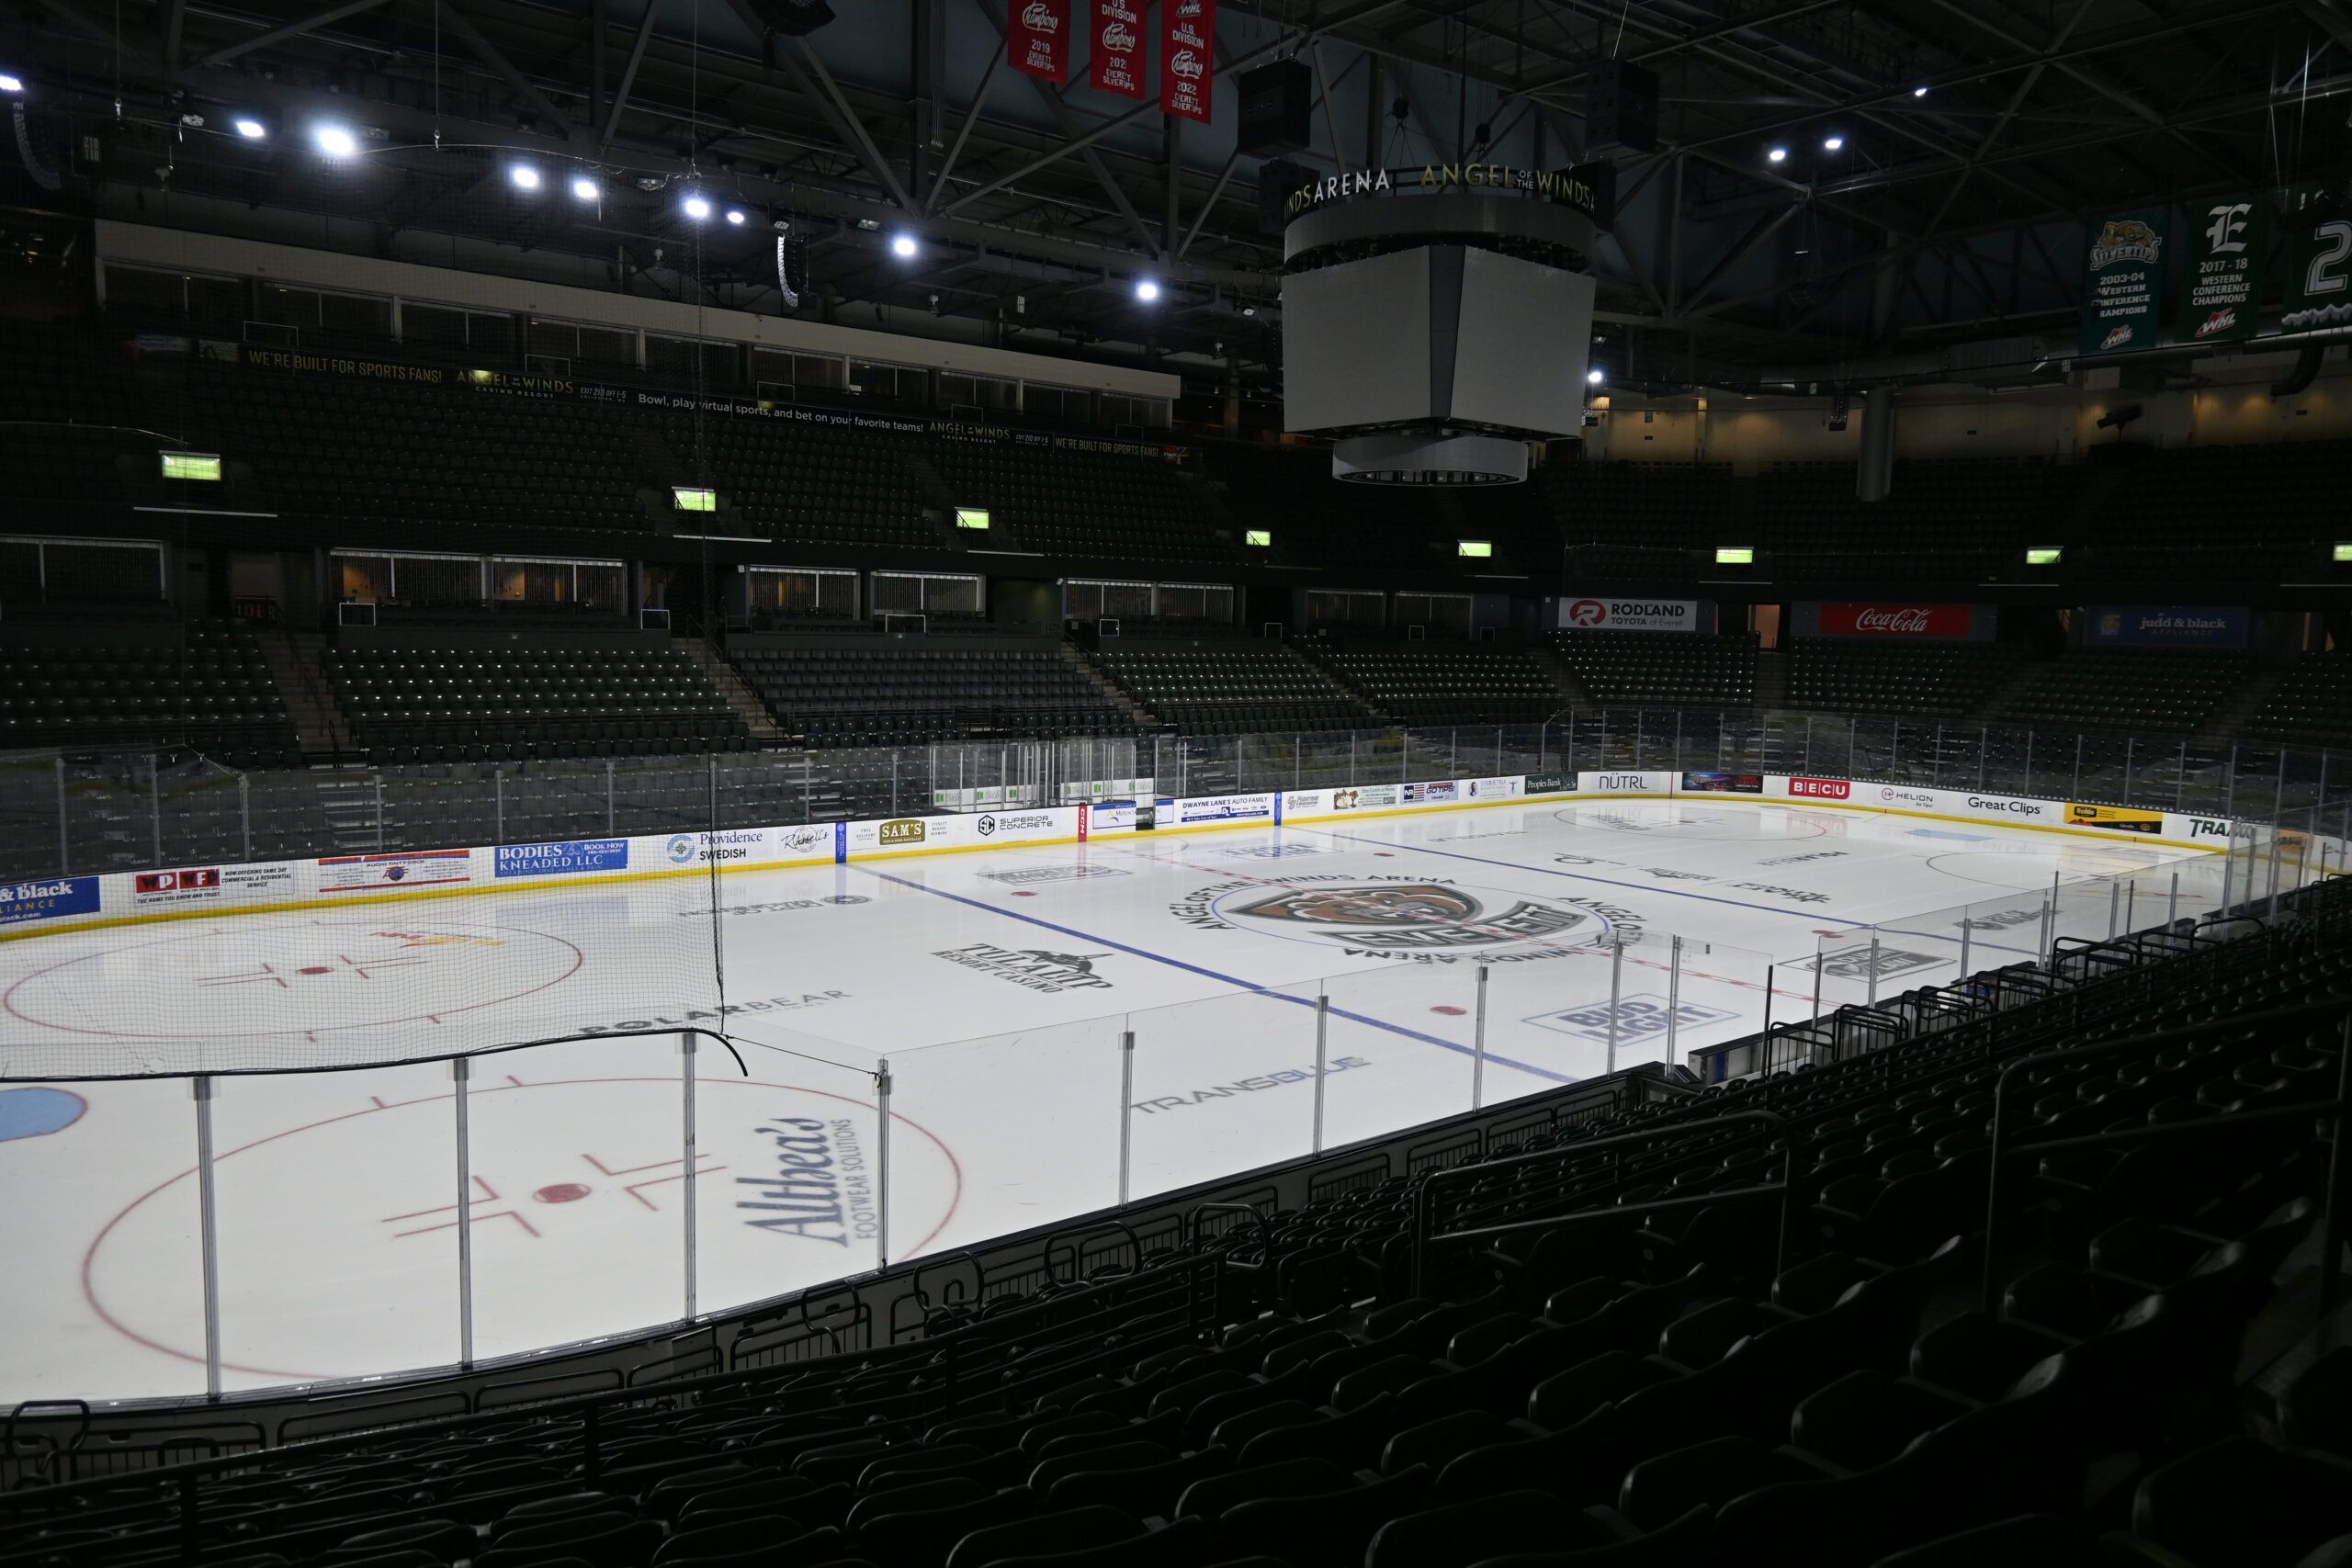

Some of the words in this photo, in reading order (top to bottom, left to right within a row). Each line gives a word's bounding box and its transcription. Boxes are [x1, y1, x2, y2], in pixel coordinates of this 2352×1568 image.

[1102, 5, 1136, 24] DIVISION
[1181, 4, 1201, 16] WHL
[1032, 39, 1050, 54] 2019
[1172, 30, 1204, 50] DIVISION
[1026, 57, 1055, 73] SILVERTIPS
[1029, 51, 1051, 64] EVERETT
[1177, 81, 1197, 95] 2022
[1420, 163, 1515, 188] ANGEL
[1519, 171, 1532, 180] OF
[1516, 179, 1534, 190] THE
[1536, 170, 1590, 209] WINDS
[1283, 185, 1311, 220] INDS
[1314, 167, 1390, 203] ARENA
[2199, 261, 2226, 275] 2017
[2234, 258, 2248, 270] 18
[2303, 220, 2352, 297] 2
[2099, 272, 2145, 286] 2003-04
[2201, 274, 2243, 286] WESTERN
[2098, 284, 2146, 296] WESTERN
[2192, 283, 2251, 297] CONFERENCE
[2192, 294, 2247, 306] CHAMPIONS
[2099, 306, 2147, 318] HAMPIONS
[2198, 312, 2237, 333] WHL
[2108, 328, 2133, 345] WHL
[249, 351, 290, 367] WE'RE
[294, 355, 328, 372] BUILT
[332, 358, 356, 375] FOR
[358, 362, 405, 380] SPORTS
[409, 367, 442, 384] FANS!
[475, 386, 513, 395] CASINO
[517, 391, 554, 400] RESORT
[522, 377, 574, 394] WINDS
[580, 387, 593, 395] EXIT
[639, 393, 670, 407] Bowl,
[673, 398, 695, 411] play
[698, 401, 732, 412] virtual
[735, 405, 771, 417] sports,
[774, 409, 792, 419] and
[796, 411, 812, 420] bet
[815, 414, 828, 423] on
[830, 416, 853, 425] your
[854, 417, 891, 430] favorite
[893, 421, 923, 433] teams!
[929, 422, 966, 435] ANGEL
[975, 426, 1011, 440] WINDS
[1055, 437, 1078, 449] WE'RE
[1079, 441, 1098, 452] BUILT
[1099, 443, 1112, 454] FOR
[1113, 445, 1139, 457] SPORTS
[1611, 604, 1685, 616] RODLAND
[1611, 617, 1646, 626] TOYOTA
[1856, 608, 1933, 632] Coca-Cola
[2139, 616, 2172, 630] judd
[2173, 618, 2185, 627] &
[2187, 617, 2227, 628] black
[1527, 779, 1547, 790] Peoples
[1547, 778, 1561, 787] Bank
[1599, 773, 1647, 790] NÜTRL
[1793, 782, 1846, 795] BECU
[1182, 801, 1209, 809] DWAYNE
[1896, 793, 1934, 803] HELION
[1968, 797, 2006, 811] Great
[2009, 802, 2041, 816] Clips
[1000, 816, 1049, 824] SUPERIOR
[1000, 821, 1054, 829] CONCRETE
[700, 831, 763, 845] Providence
[882, 822, 922, 838] SAM'S
[499, 844, 562, 860] BODIES
[699, 849, 747, 861] SWEDISH
[500, 857, 571, 871] KNEADED
[577, 855, 604, 866] LLC
[141, 874, 174, 889] WP
[1268, 874, 1355, 884] WINDS
[1367, 874, 1456, 885] ARENA
[17, 882, 73, 900] black
[1201, 880, 1258, 896] THE
[1184, 891, 1215, 903] OF
[1169, 903, 1238, 930] ANGEL
[930, 950, 1001, 973] RESORT
[993, 971, 1064, 993] CASINO
[959, 942, 1114, 989] TULALIP
[1556, 1001, 1659, 1027] BUD
[1579, 1006, 1716, 1043] LIGHT
[1130, 1056, 1372, 1115] TRANSBLUE
[831, 1119, 865, 1172] SOLUTIONS
[844, 1175, 879, 1240] FOOTWEAR
